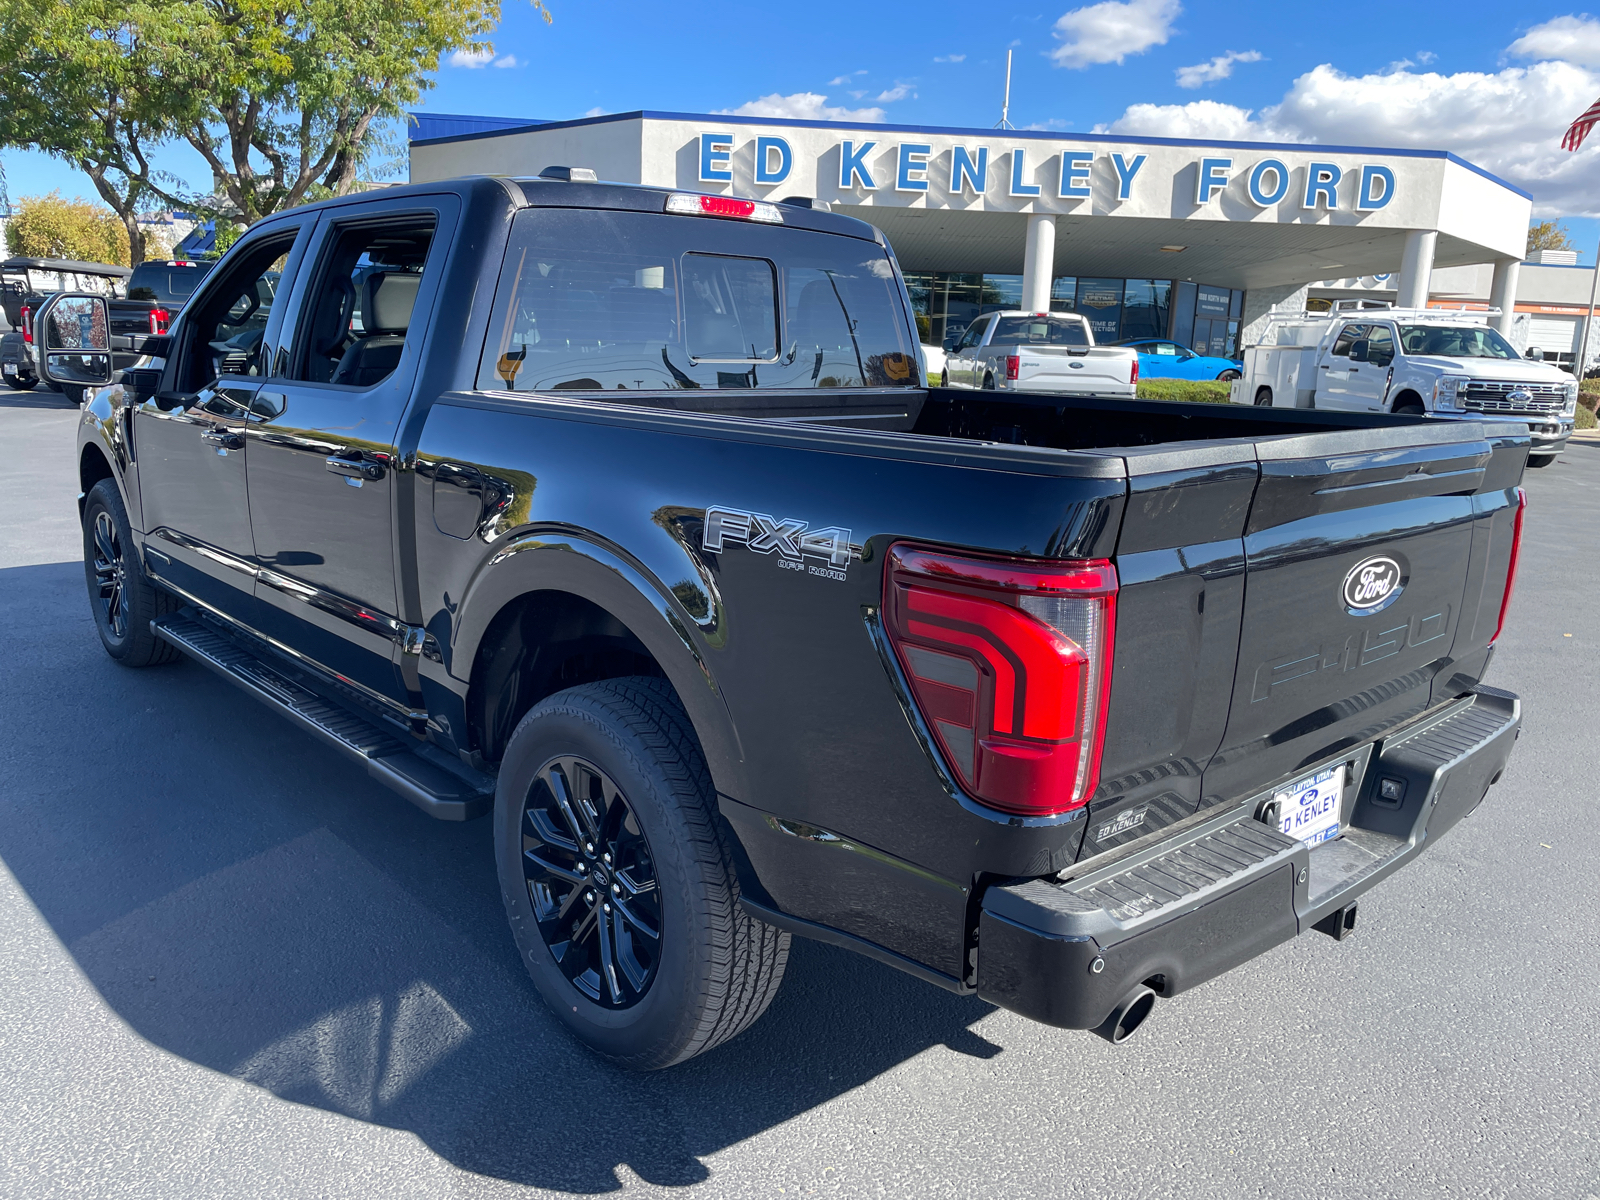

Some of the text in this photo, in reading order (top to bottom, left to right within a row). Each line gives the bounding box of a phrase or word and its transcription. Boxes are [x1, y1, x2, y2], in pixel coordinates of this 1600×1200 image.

[699, 132, 1398, 212] ED KENLEY FORD
[702, 505, 852, 571] FX4
[778, 559, 847, 582] OFF ROAD
[1352, 563, 1394, 603] Ford
[1097, 826, 1111, 839] ED
[1111, 811, 1147, 833] KENLEY
[1295, 793, 1338, 828] KENLEY
[1304, 830, 1326, 850] NLEY
